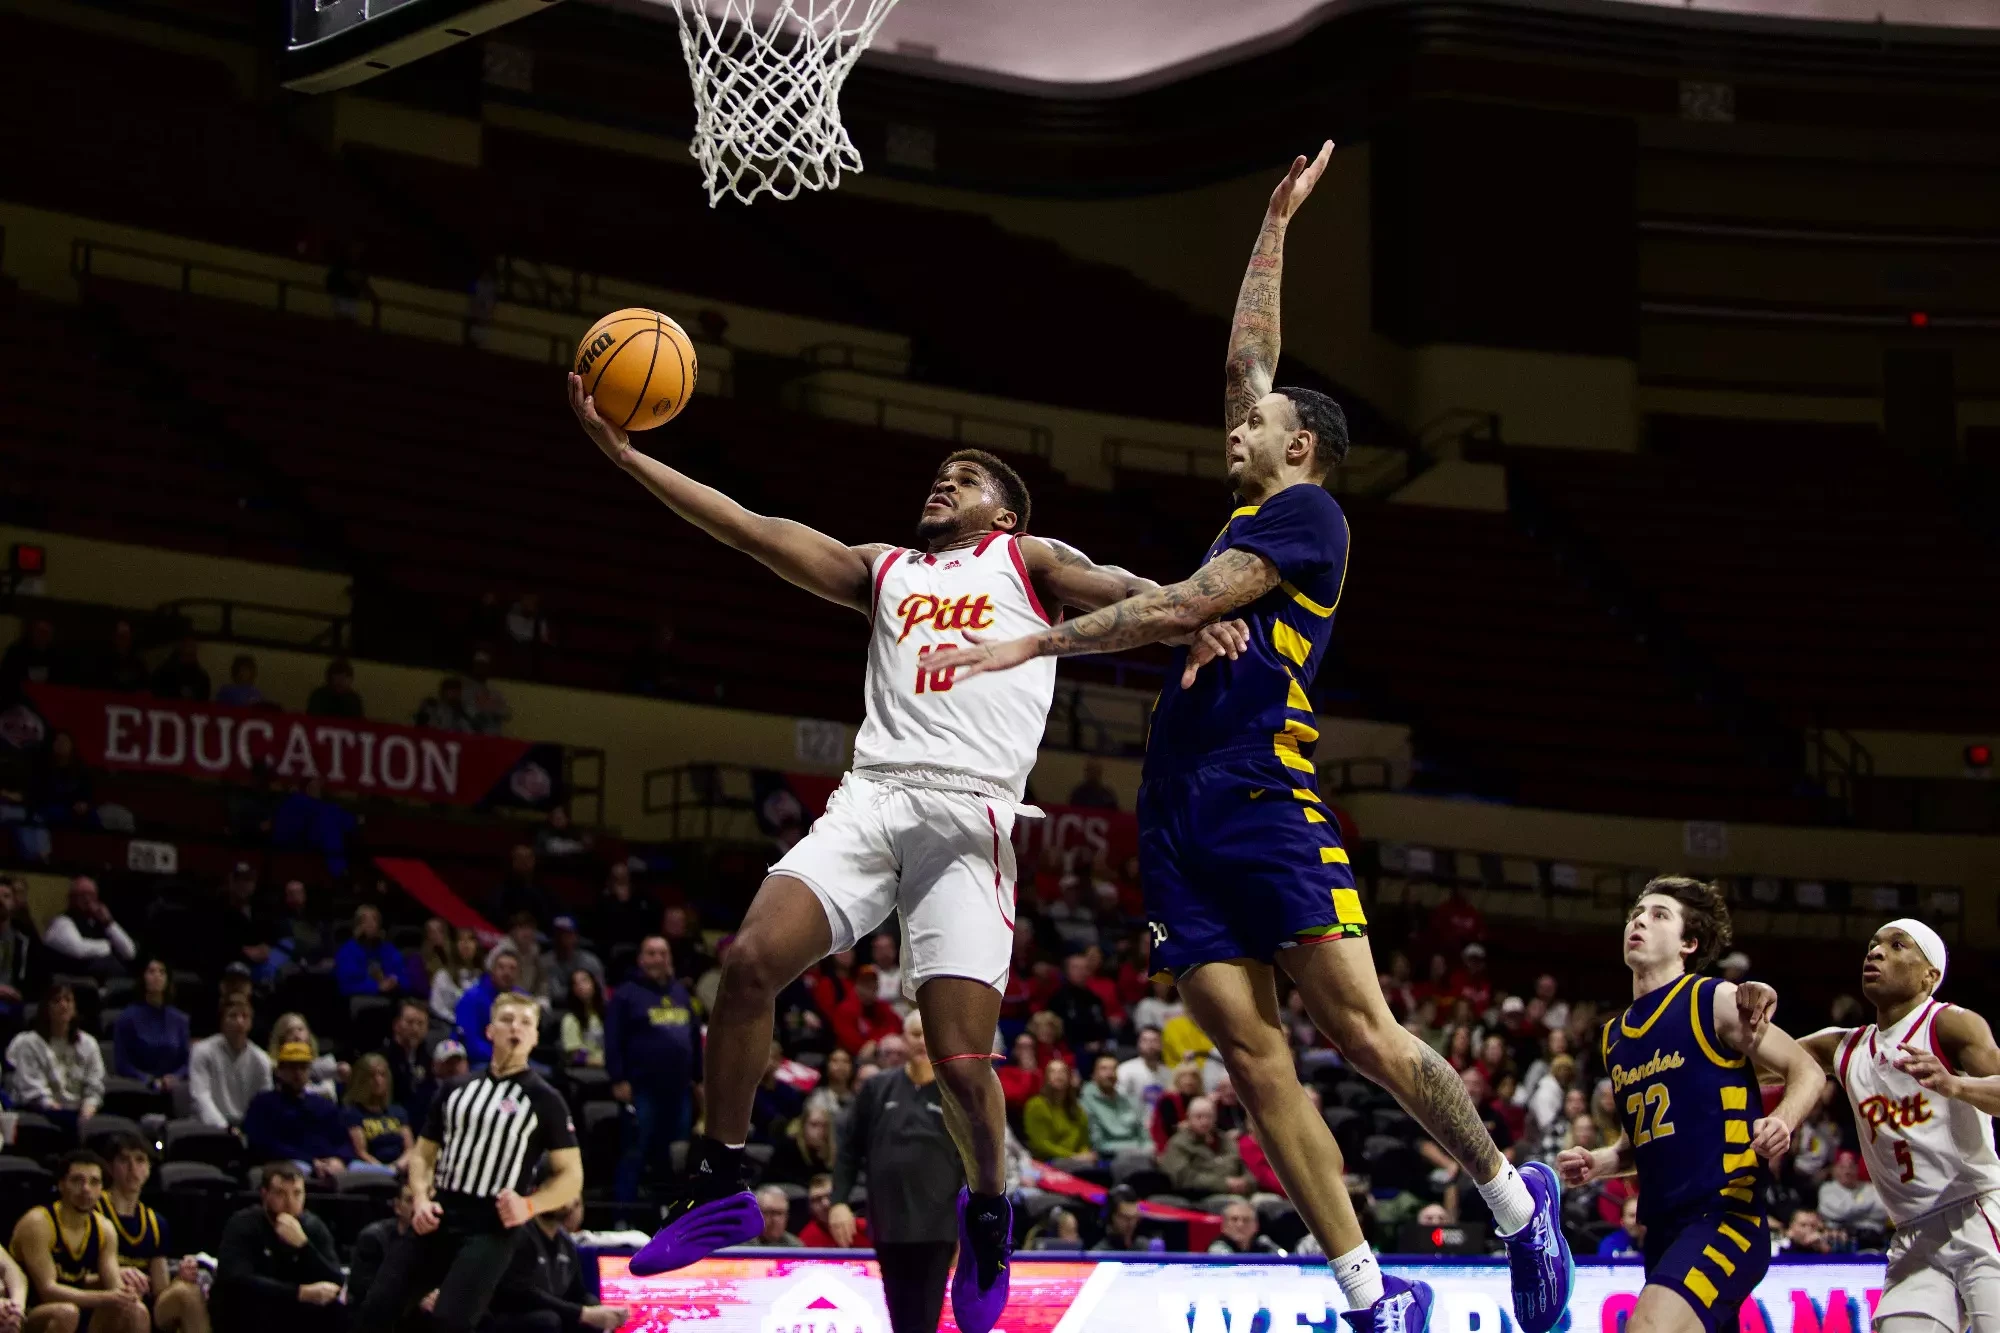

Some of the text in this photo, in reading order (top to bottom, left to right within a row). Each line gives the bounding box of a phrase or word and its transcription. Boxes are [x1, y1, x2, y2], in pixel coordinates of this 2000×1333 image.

[896, 593, 995, 646] Pitt
[104, 705, 461, 793] EDUCATION
[1611, 1048, 1685, 1093] Bronchos
[1626, 1082, 1676, 1148] 22
[1858, 1091, 1933, 1144] Pitt
[1893, 1139, 1915, 1184] 5
